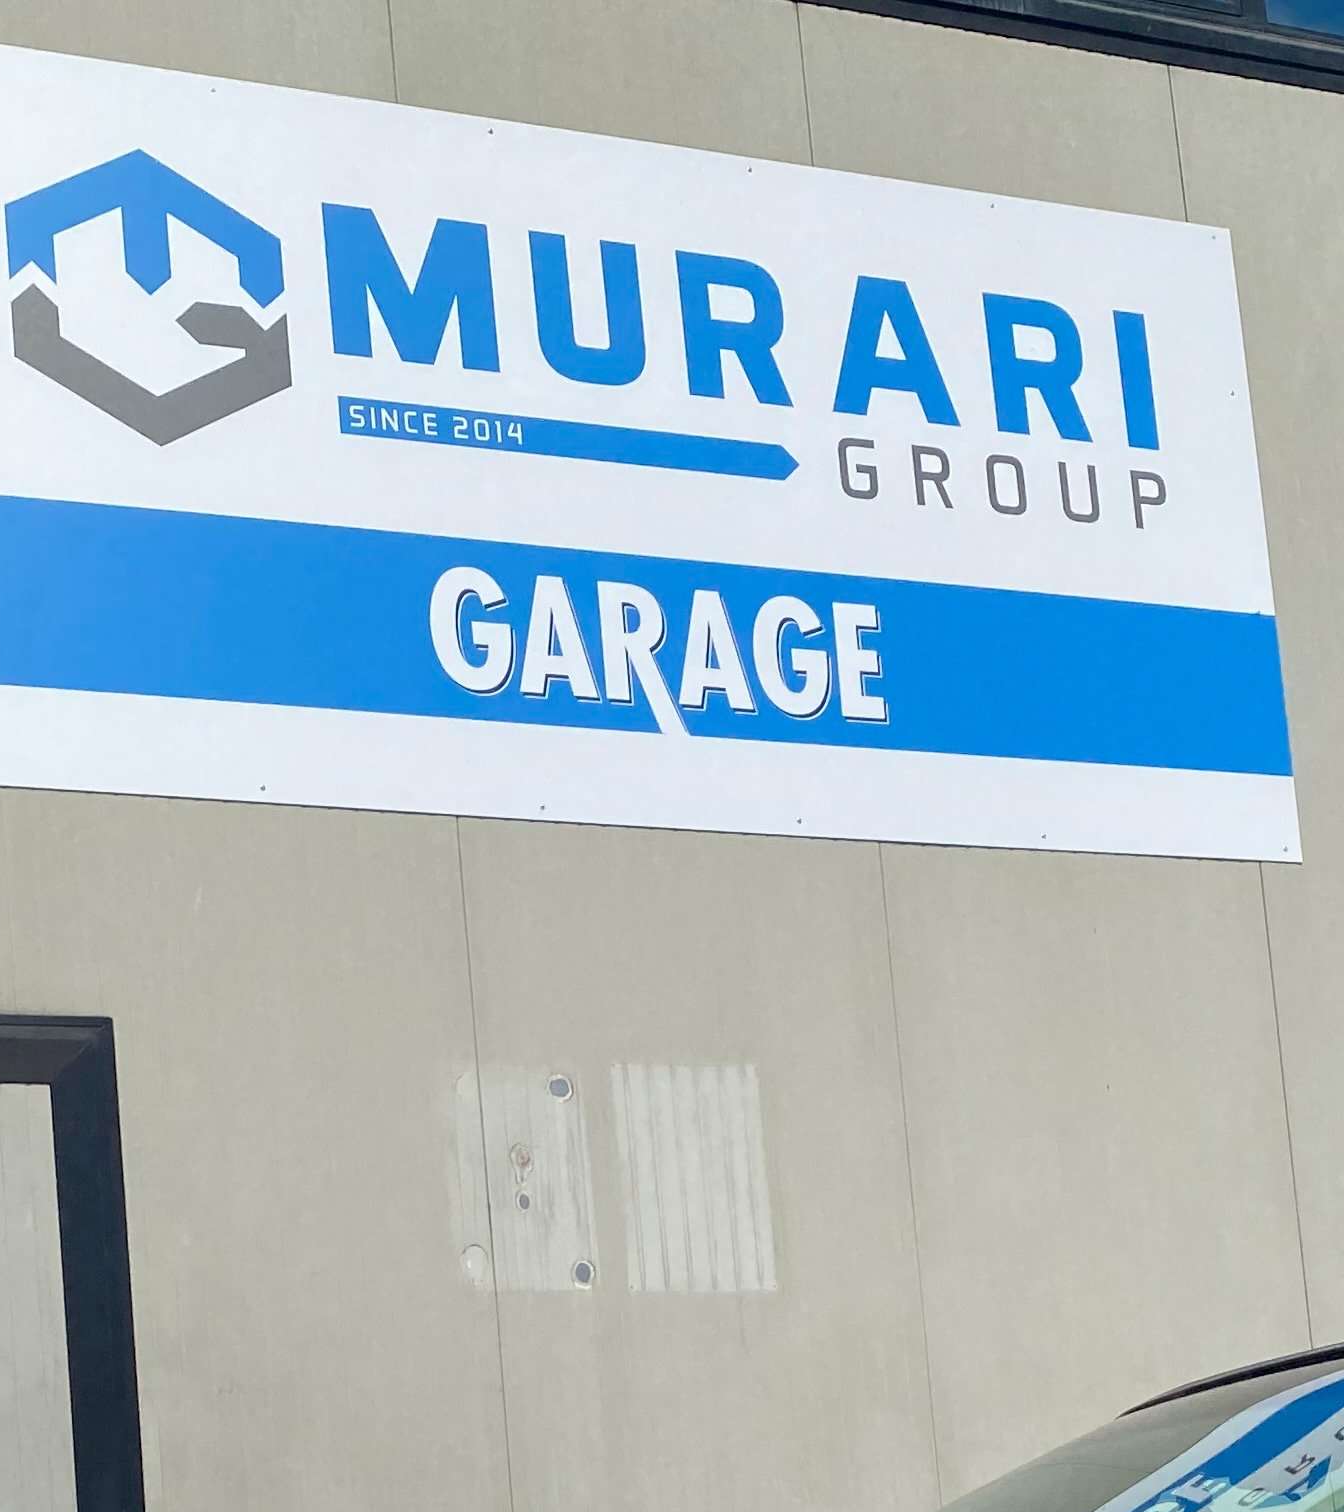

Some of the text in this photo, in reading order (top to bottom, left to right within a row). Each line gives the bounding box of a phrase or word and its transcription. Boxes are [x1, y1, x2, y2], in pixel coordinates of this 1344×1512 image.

[321, 202, 1160, 451] MURARI
[349, 405, 523, 445] SINCE 2014
[836, 437, 1167, 530] GROUP
[429, 566, 889, 735] GARAGE
